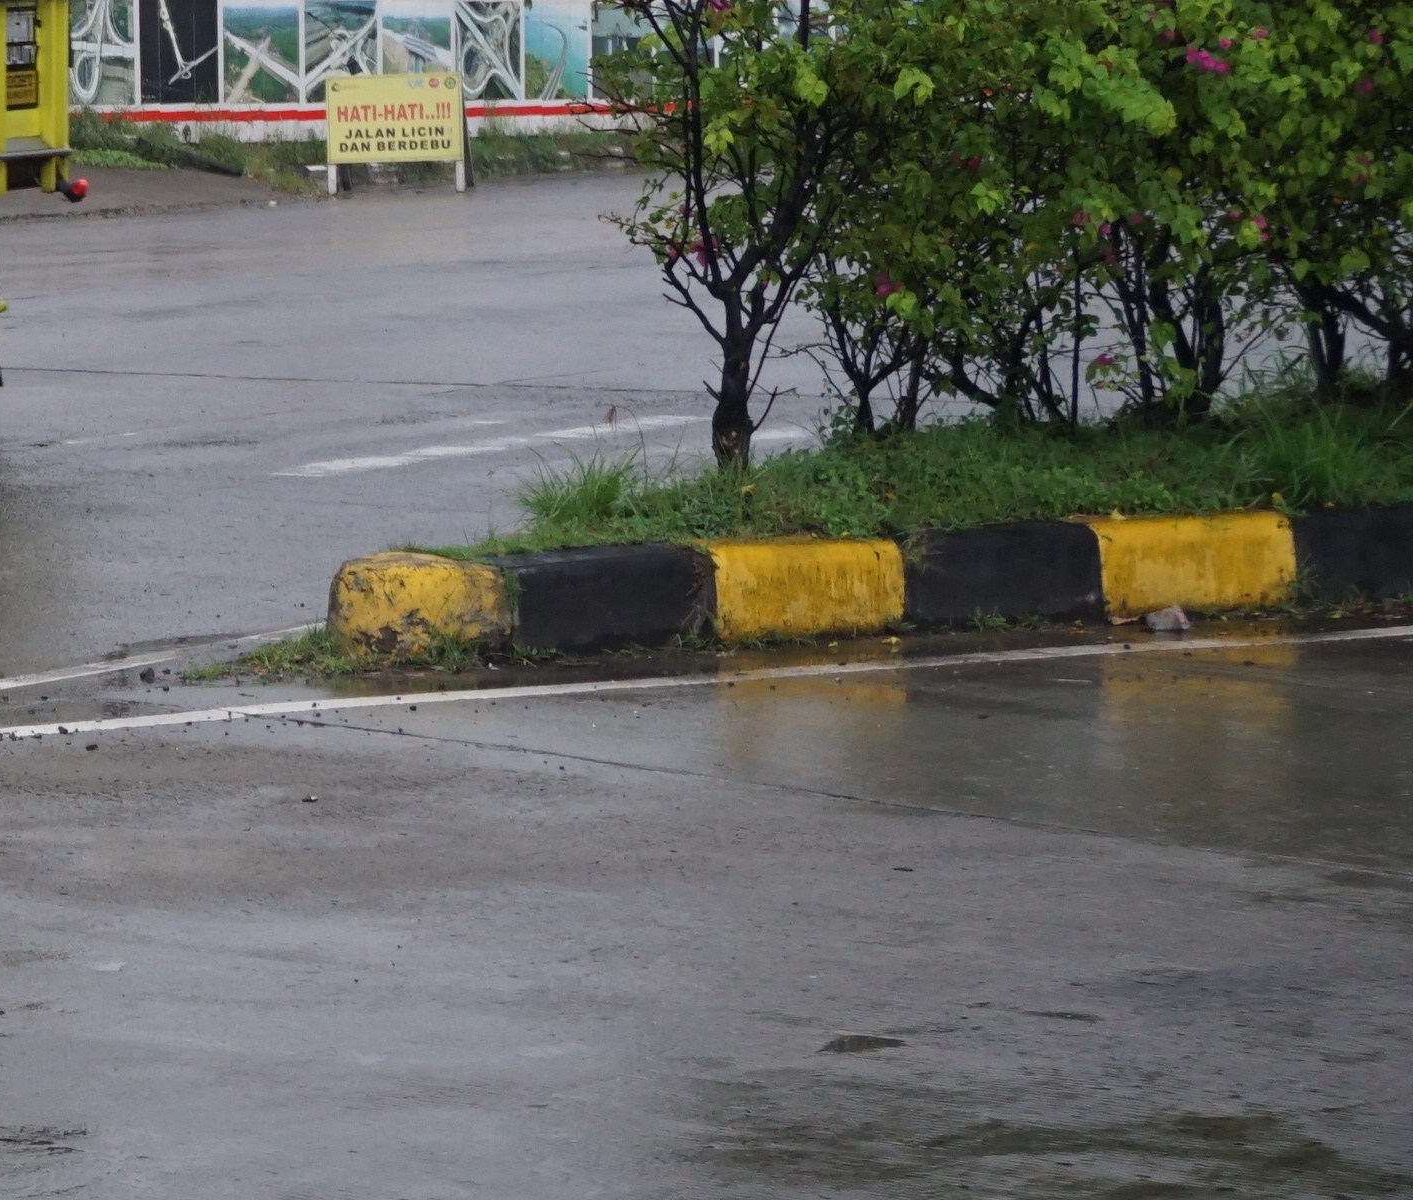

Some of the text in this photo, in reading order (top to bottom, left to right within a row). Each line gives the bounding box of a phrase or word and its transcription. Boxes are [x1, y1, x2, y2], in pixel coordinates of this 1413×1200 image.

[345, 126, 444, 139] JALAN LICIN
[339, 139, 451, 153] DAN BERDEBU
